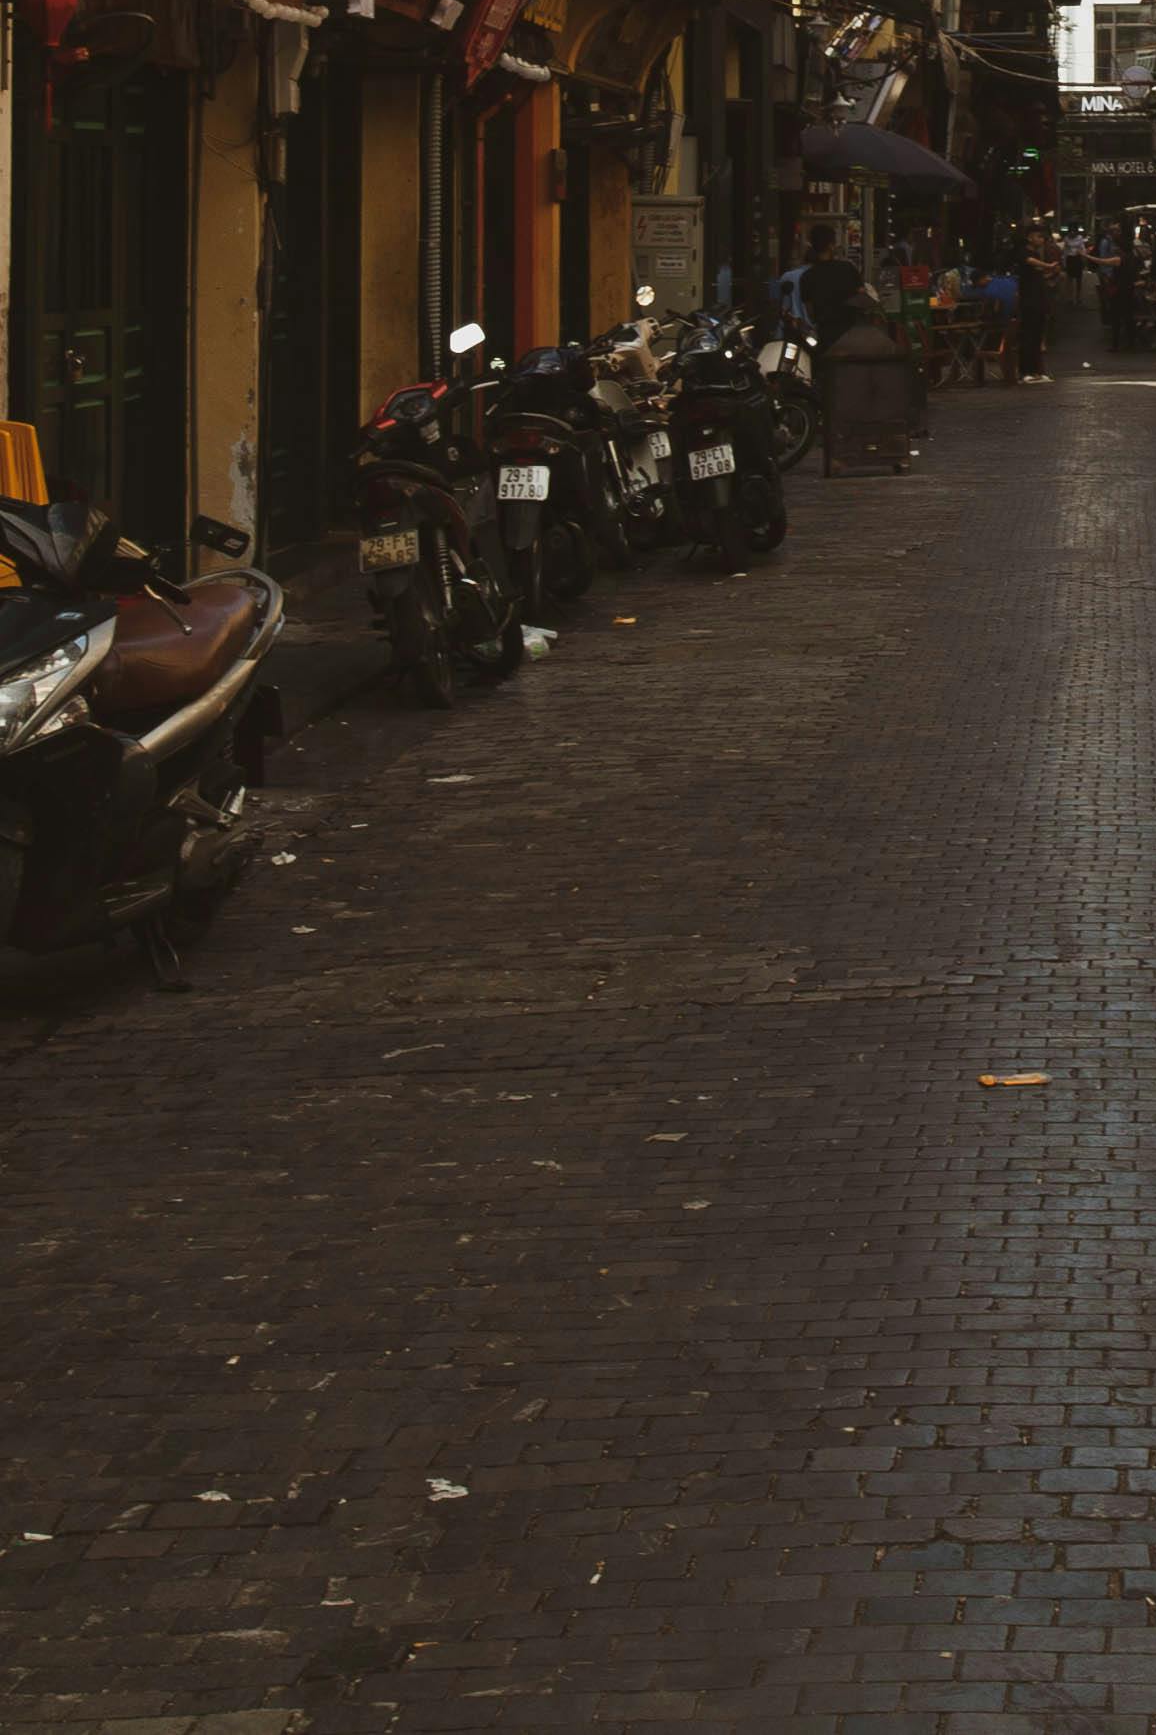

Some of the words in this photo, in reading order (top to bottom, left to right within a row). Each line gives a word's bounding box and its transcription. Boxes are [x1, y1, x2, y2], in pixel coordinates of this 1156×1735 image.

[1081, 95, 1123, 112] MINA
[1091, 162, 1116, 174] MINA
[1118, 161, 1147, 174] HOTEL
[694, 447, 727, 465] 29-C1
[693, 459, 731, 478] 976.08
[501, 483, 544, 498] 917.80
